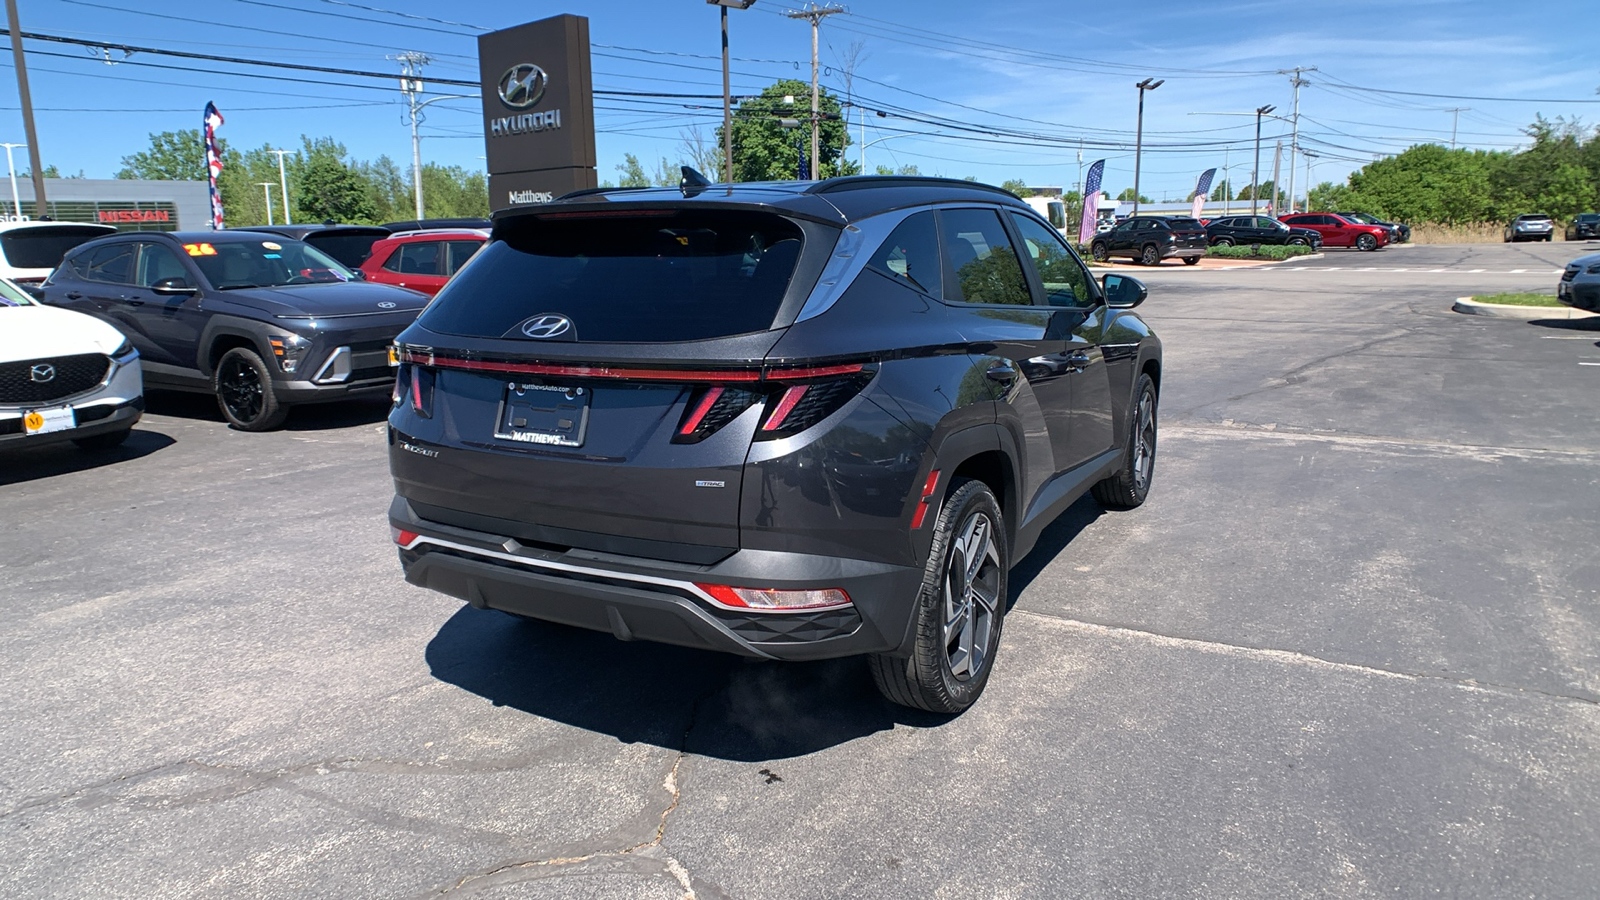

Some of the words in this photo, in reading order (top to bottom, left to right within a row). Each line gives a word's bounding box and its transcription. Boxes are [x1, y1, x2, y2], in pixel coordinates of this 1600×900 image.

[490, 109, 560, 136] HYUNDAI
[508, 189, 553, 204] Matthews
[99, 210, 169, 222] NISSAN
[184, 243, 216, 256] 26
[521, 383, 570, 393] MatthewsAuto.com
[512, 431, 561, 445] MATTHEWS
